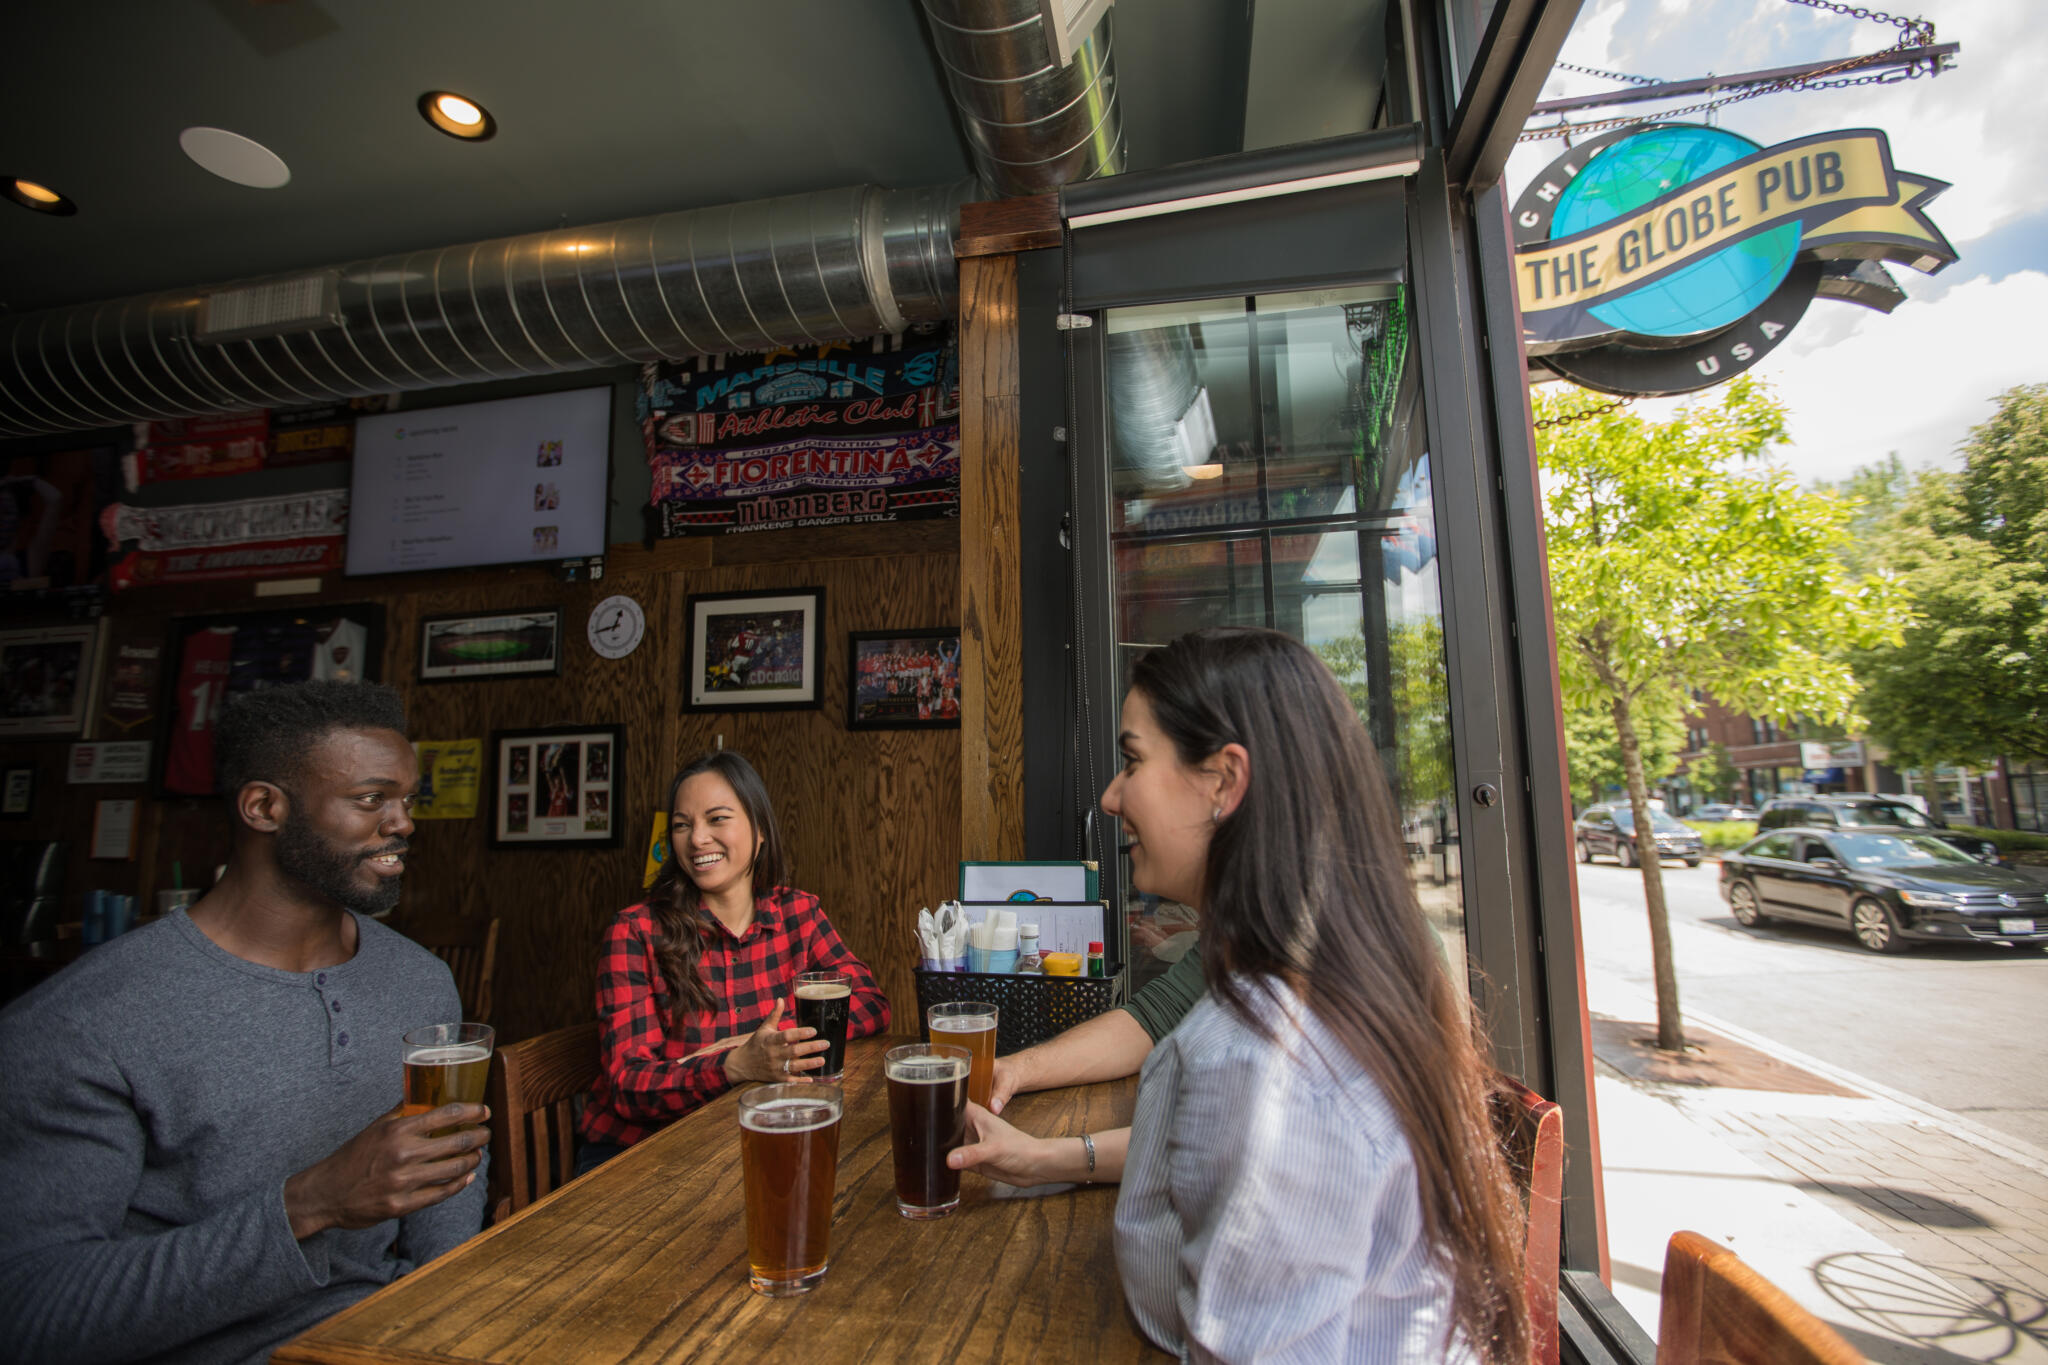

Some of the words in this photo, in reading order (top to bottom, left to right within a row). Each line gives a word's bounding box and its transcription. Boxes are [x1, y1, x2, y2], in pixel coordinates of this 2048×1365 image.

[1525, 245, 1602, 299] THE
[1618, 182, 1741, 274] GLOBE
[1757, 151, 1845, 213] PUB
[1695, 320, 1785, 376] USA
[696, 359, 886, 411] MARSEILLE
[717, 403, 838, 440] Athletic
[842, 393, 918, 425] Club
[714, 447, 912, 488] FIORENTINA
[725, 520, 794, 535] FRANKENS
[797, 514, 851, 527] GANZER
[853, 512, 897, 523] STOLZ
